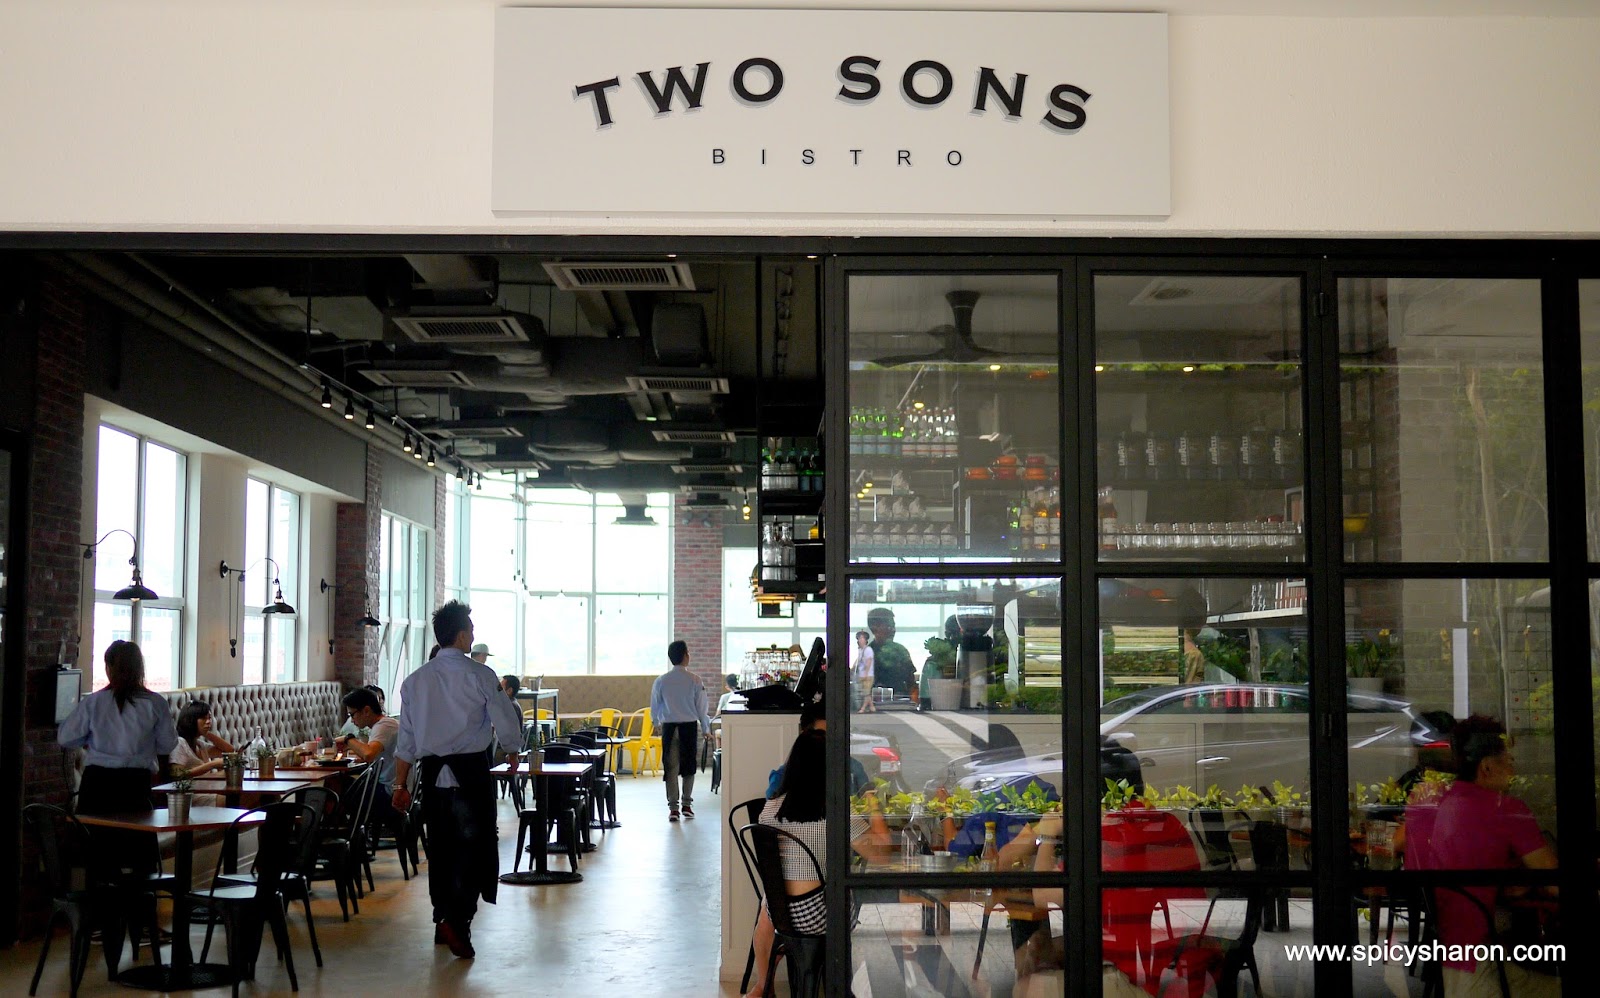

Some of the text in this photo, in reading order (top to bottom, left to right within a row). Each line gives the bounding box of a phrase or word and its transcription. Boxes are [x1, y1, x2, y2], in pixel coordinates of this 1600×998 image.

[574, 55, 1092, 131] TWO SONS
[712, 148, 963, 167] BISTRO
